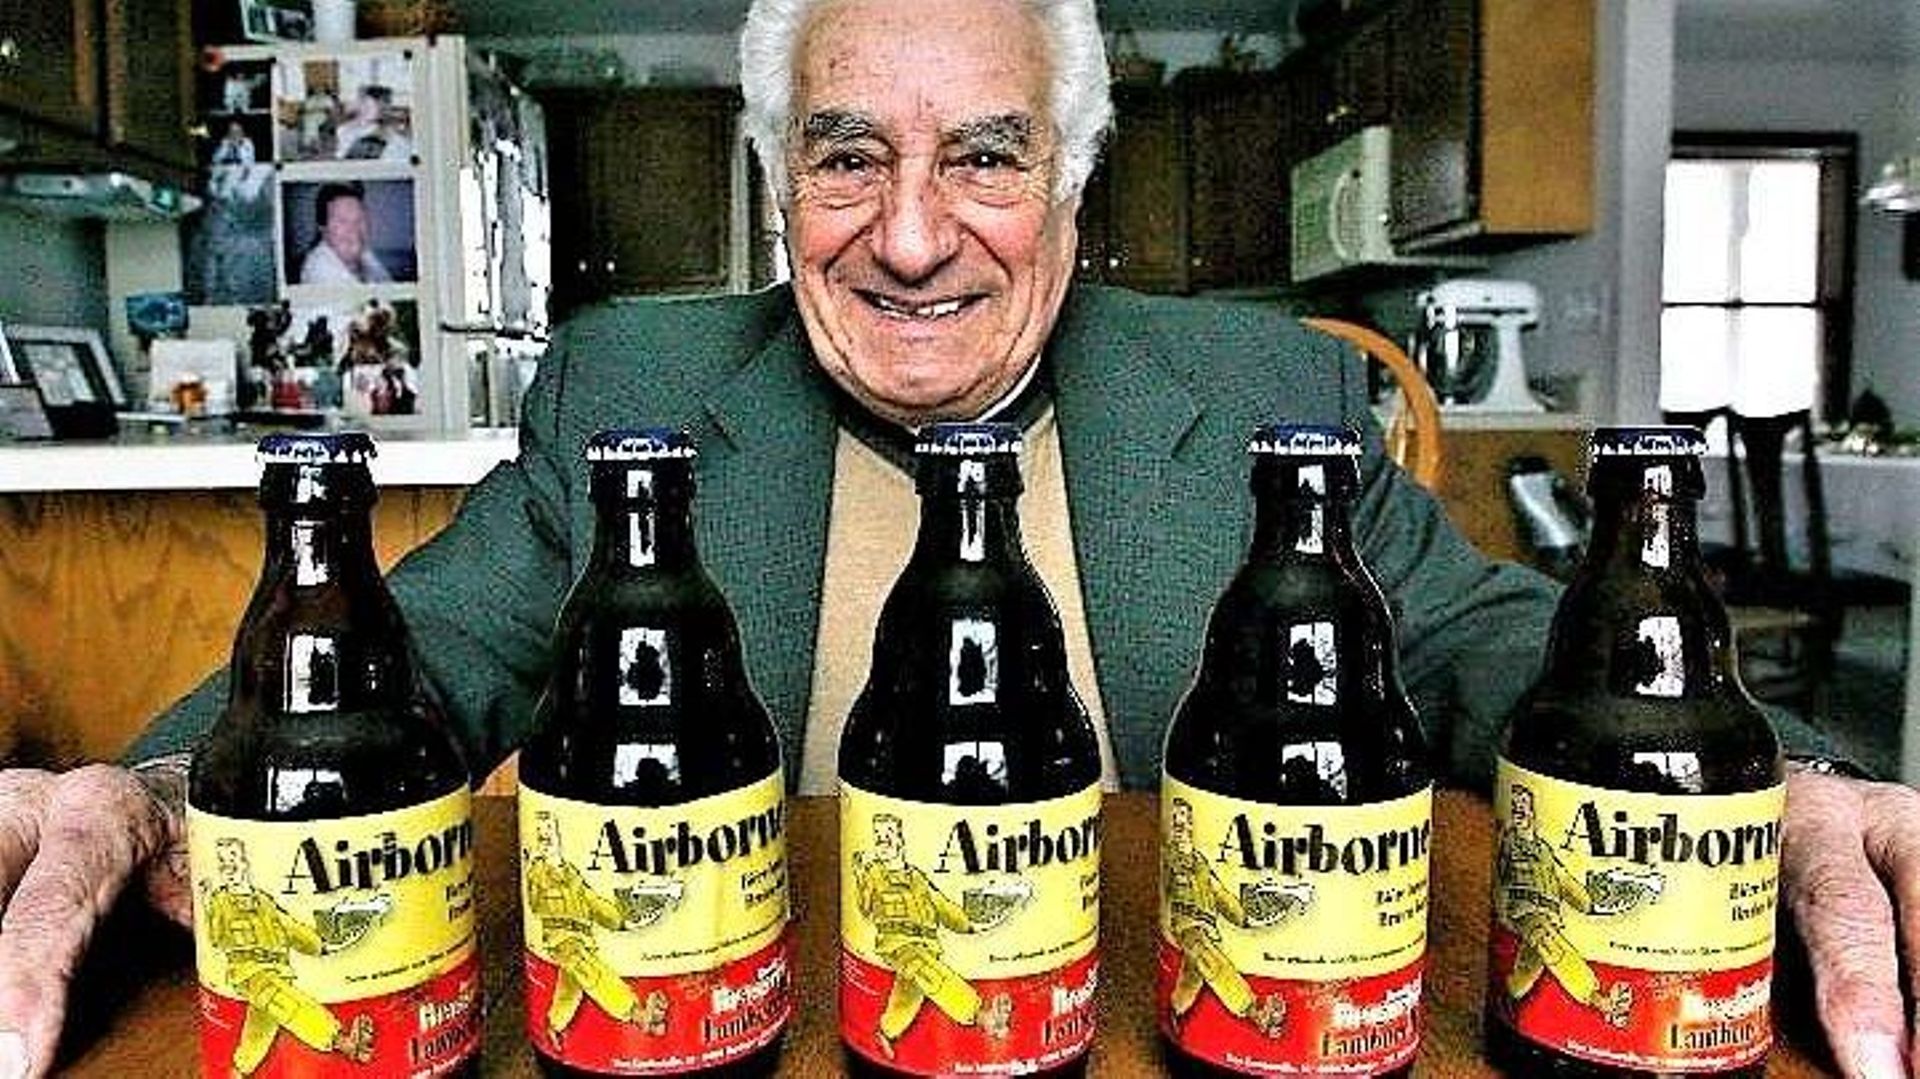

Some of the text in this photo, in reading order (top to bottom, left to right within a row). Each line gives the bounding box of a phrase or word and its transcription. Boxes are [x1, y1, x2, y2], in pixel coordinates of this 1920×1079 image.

[282, 819, 472, 894] Airborn
[934, 815, 1099, 875] Airborn
[1560, 800, 1781, 868] Airborn
